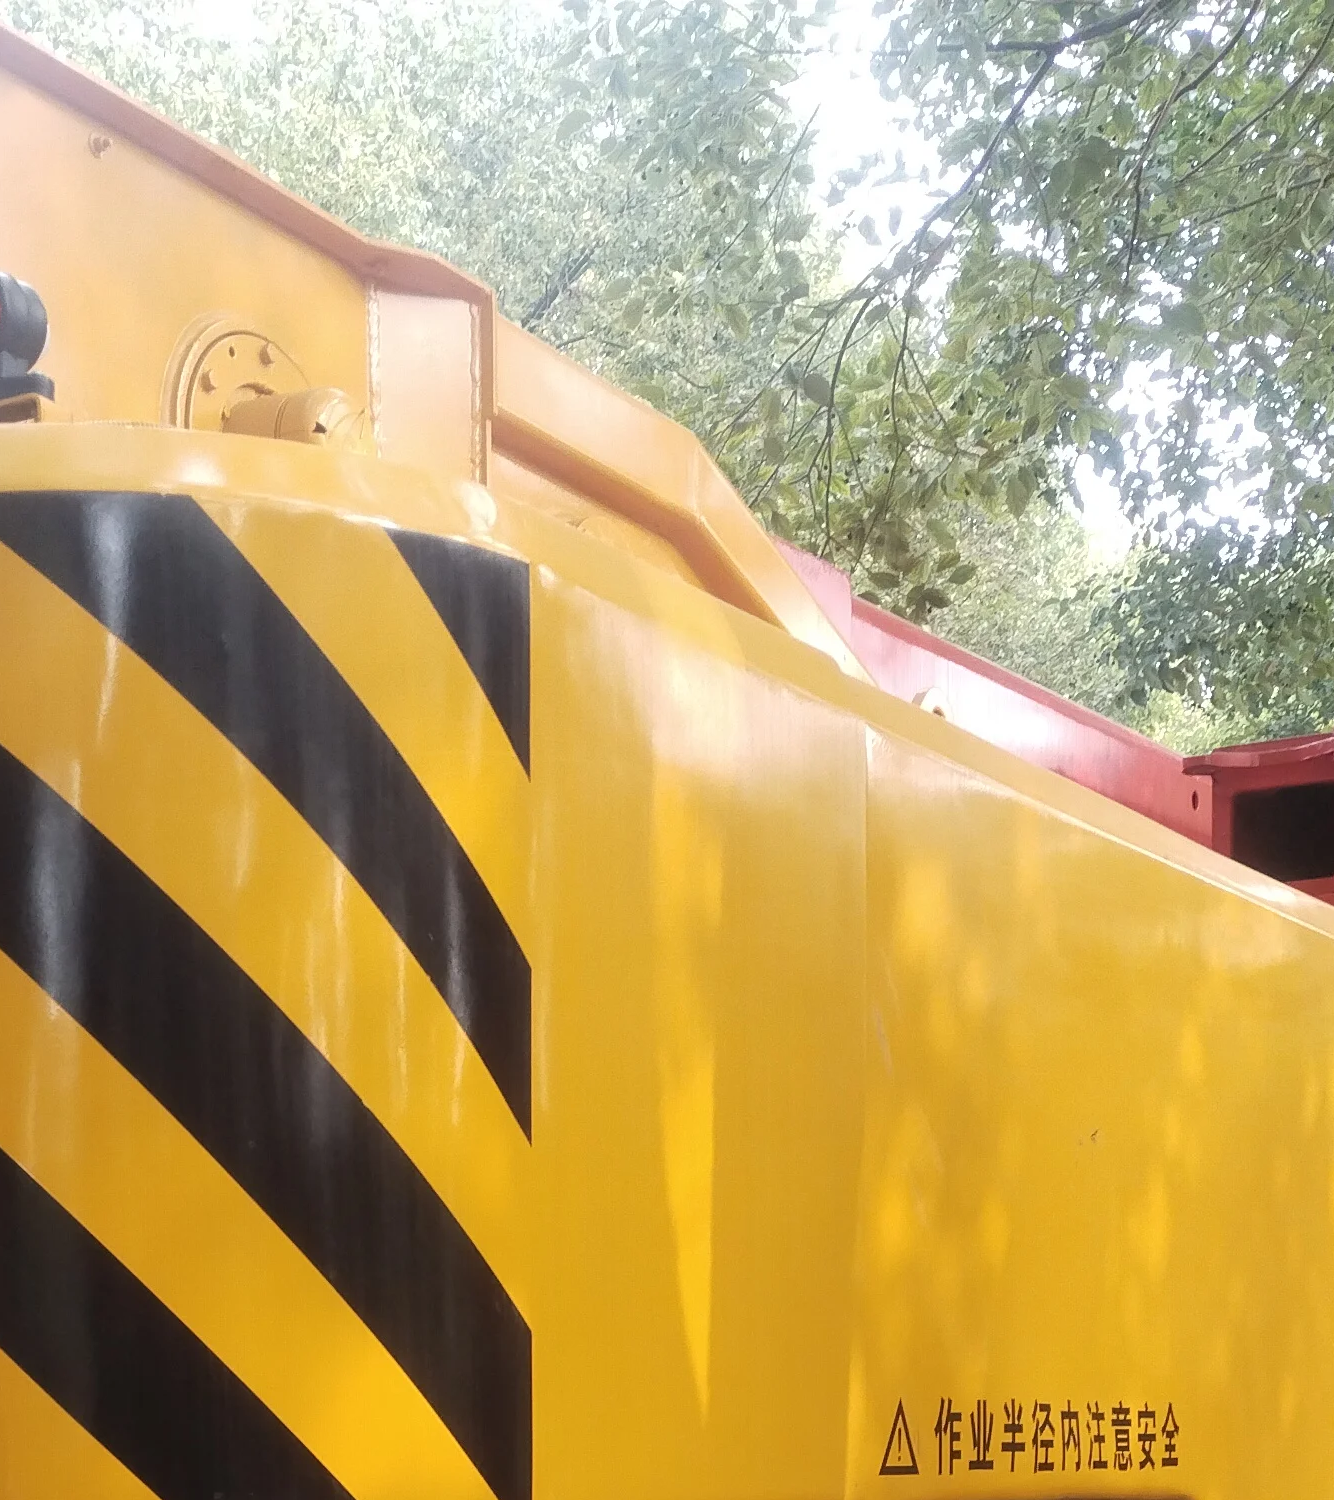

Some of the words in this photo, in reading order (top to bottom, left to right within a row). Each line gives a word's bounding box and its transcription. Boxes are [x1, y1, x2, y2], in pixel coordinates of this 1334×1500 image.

[934, 1397, 1180, 1476] 作业半径内注意安全
